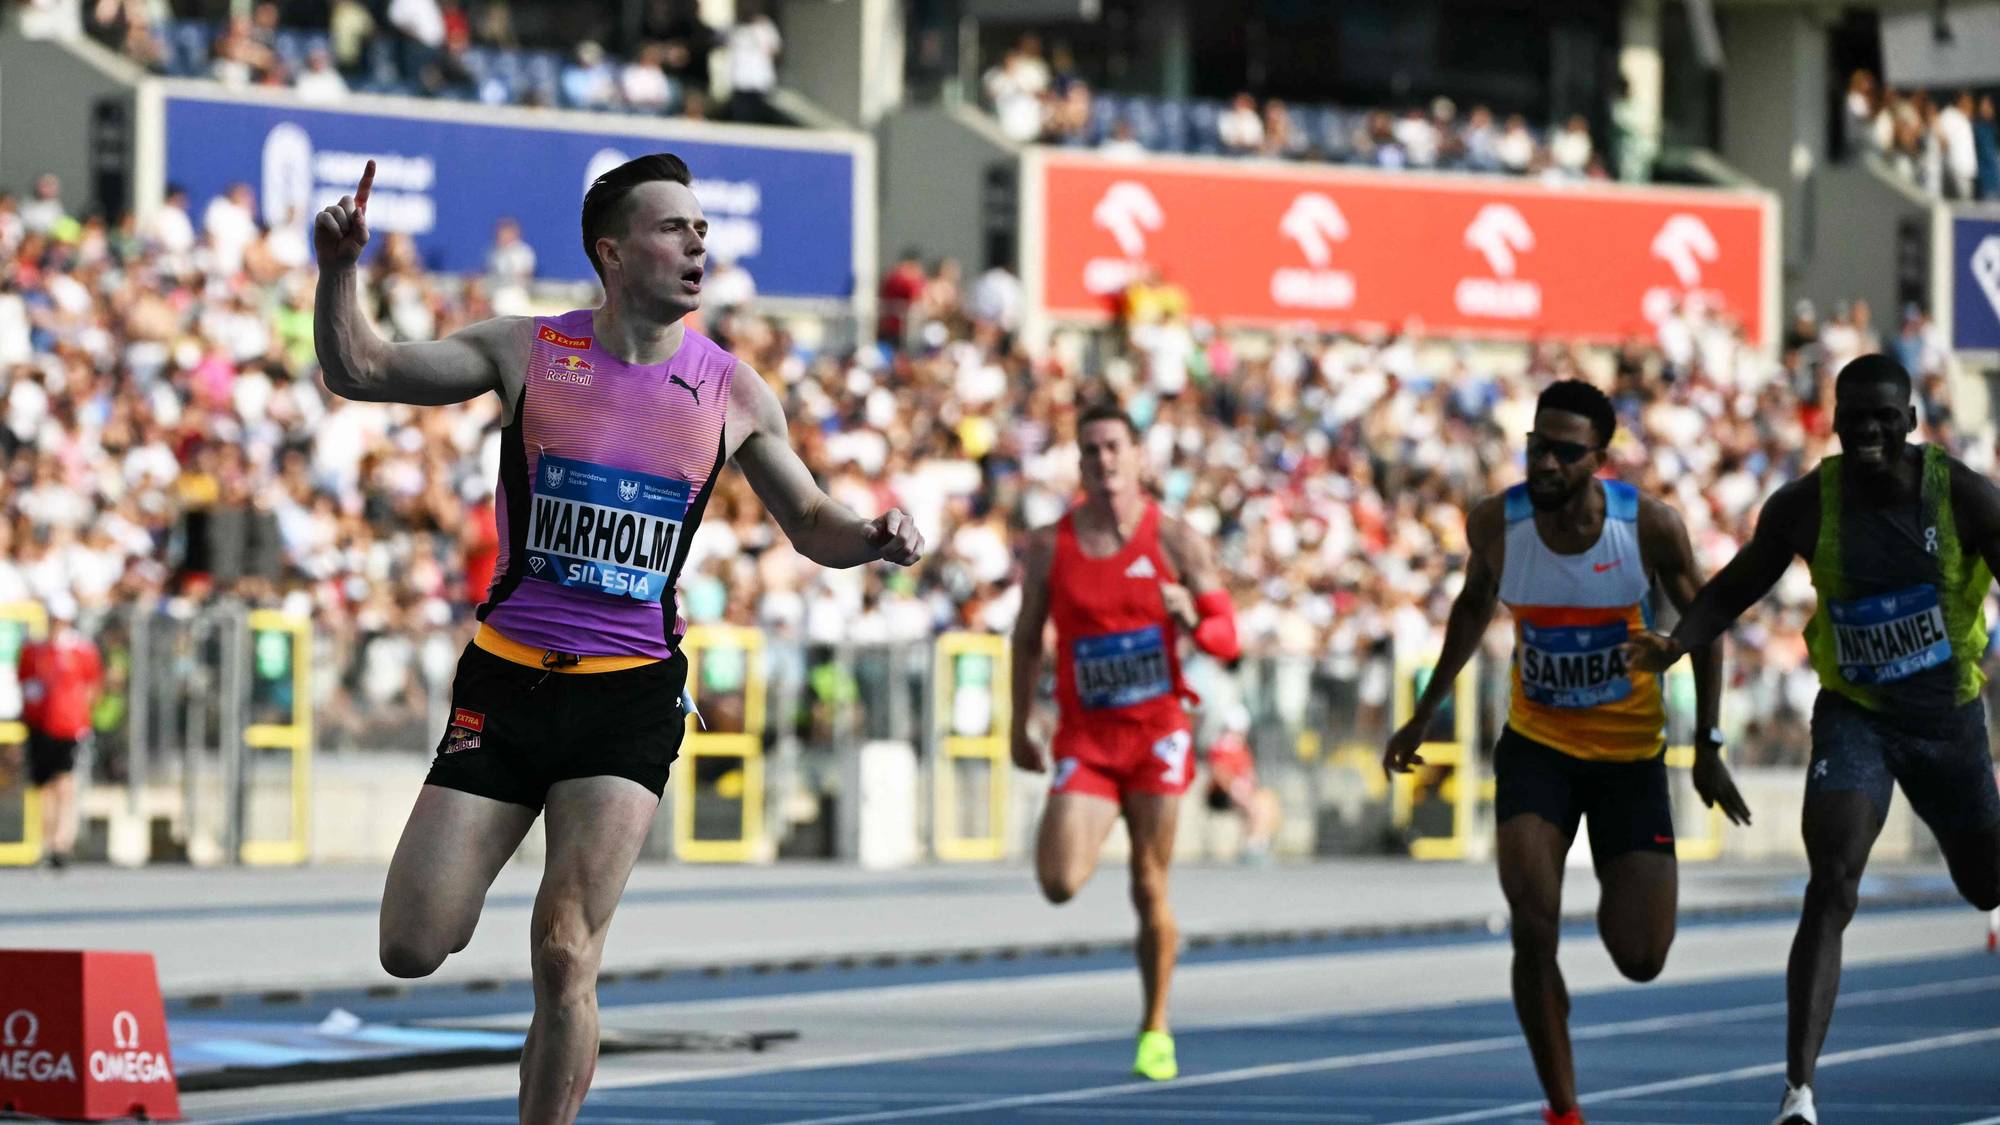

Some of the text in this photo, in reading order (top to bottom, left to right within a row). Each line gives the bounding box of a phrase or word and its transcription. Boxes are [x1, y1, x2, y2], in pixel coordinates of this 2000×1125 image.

[557, 336, 586, 346] EXTRA
[546, 369, 592, 386] Red Bull
[534, 498, 676, 573] WARHOLM
[567, 563, 649, 595] SILESIA
[1837, 610, 1944, 664] NATHANIEL
[1524, 647, 1626, 689] SAMBA
[1875, 650, 1938, 681] SILESIA
[456, 713, 479, 726] EXTRA
[89, 1050, 173, 1083] OMEGA
